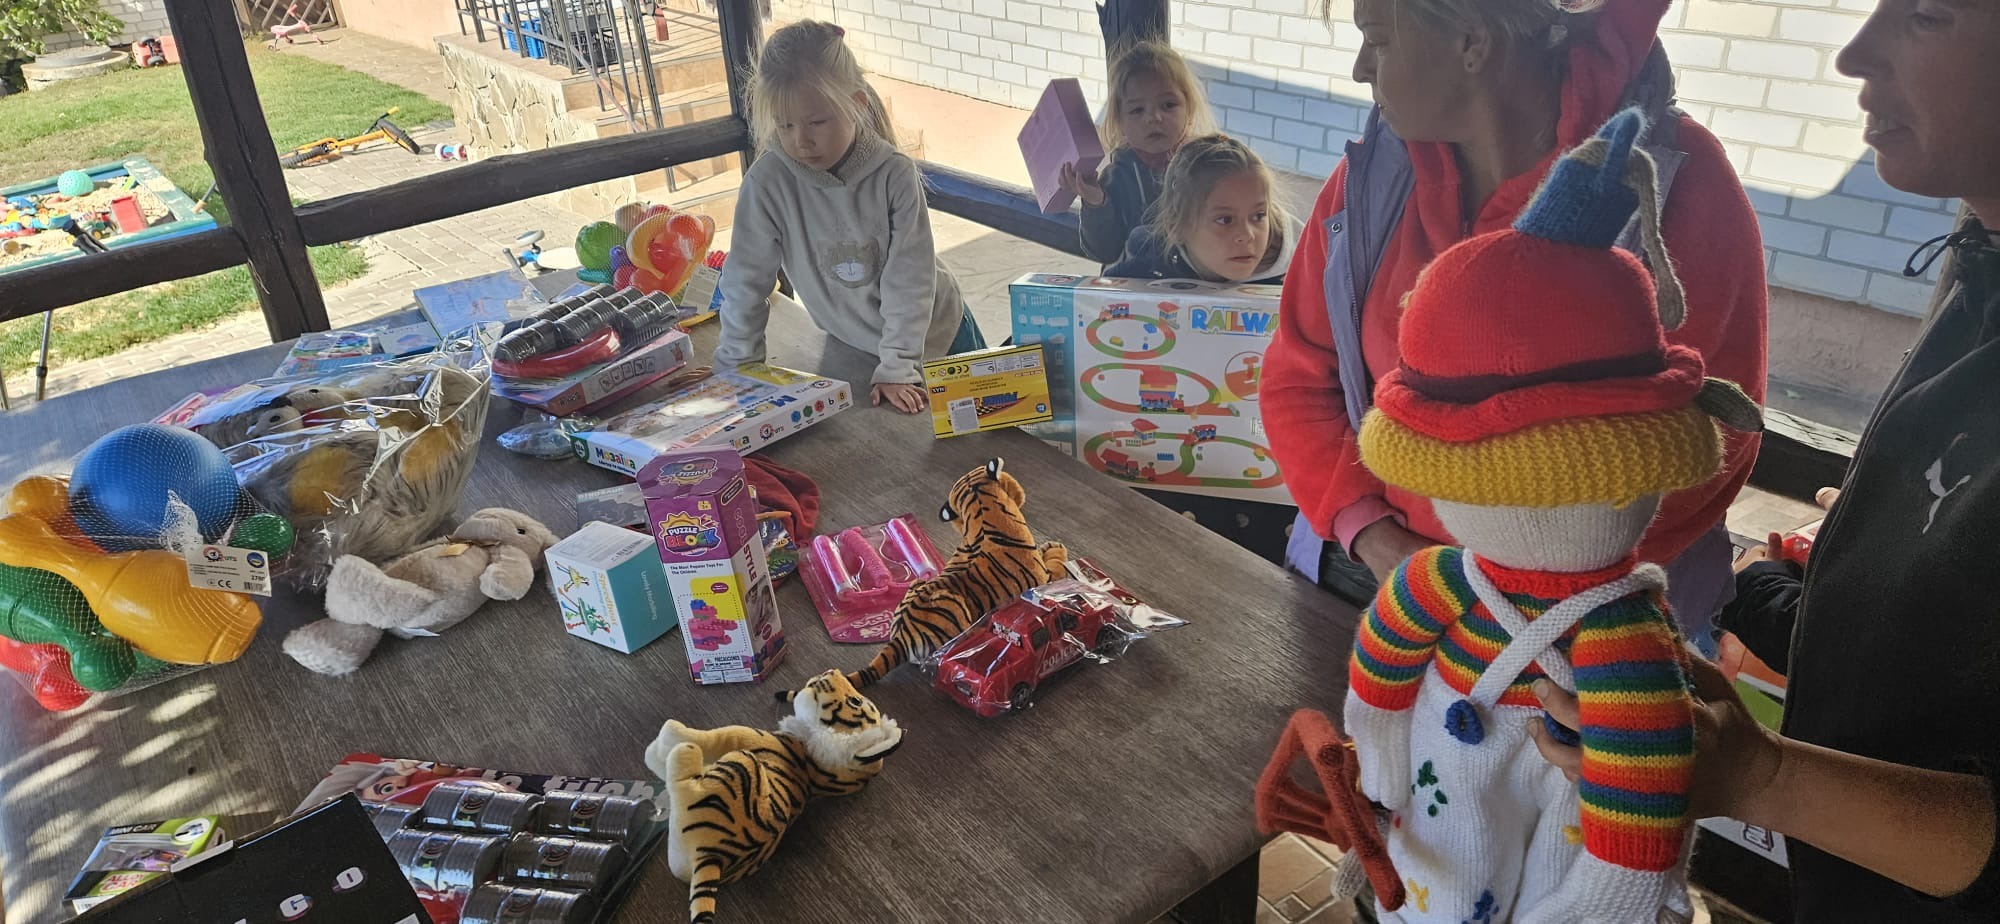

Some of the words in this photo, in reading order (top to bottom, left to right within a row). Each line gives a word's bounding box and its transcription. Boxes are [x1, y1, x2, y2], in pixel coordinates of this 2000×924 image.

[665, 529, 717, 548] BLOCK
[667, 527, 699, 536] PUZZLE
[743, 543, 758, 582] STYLE
